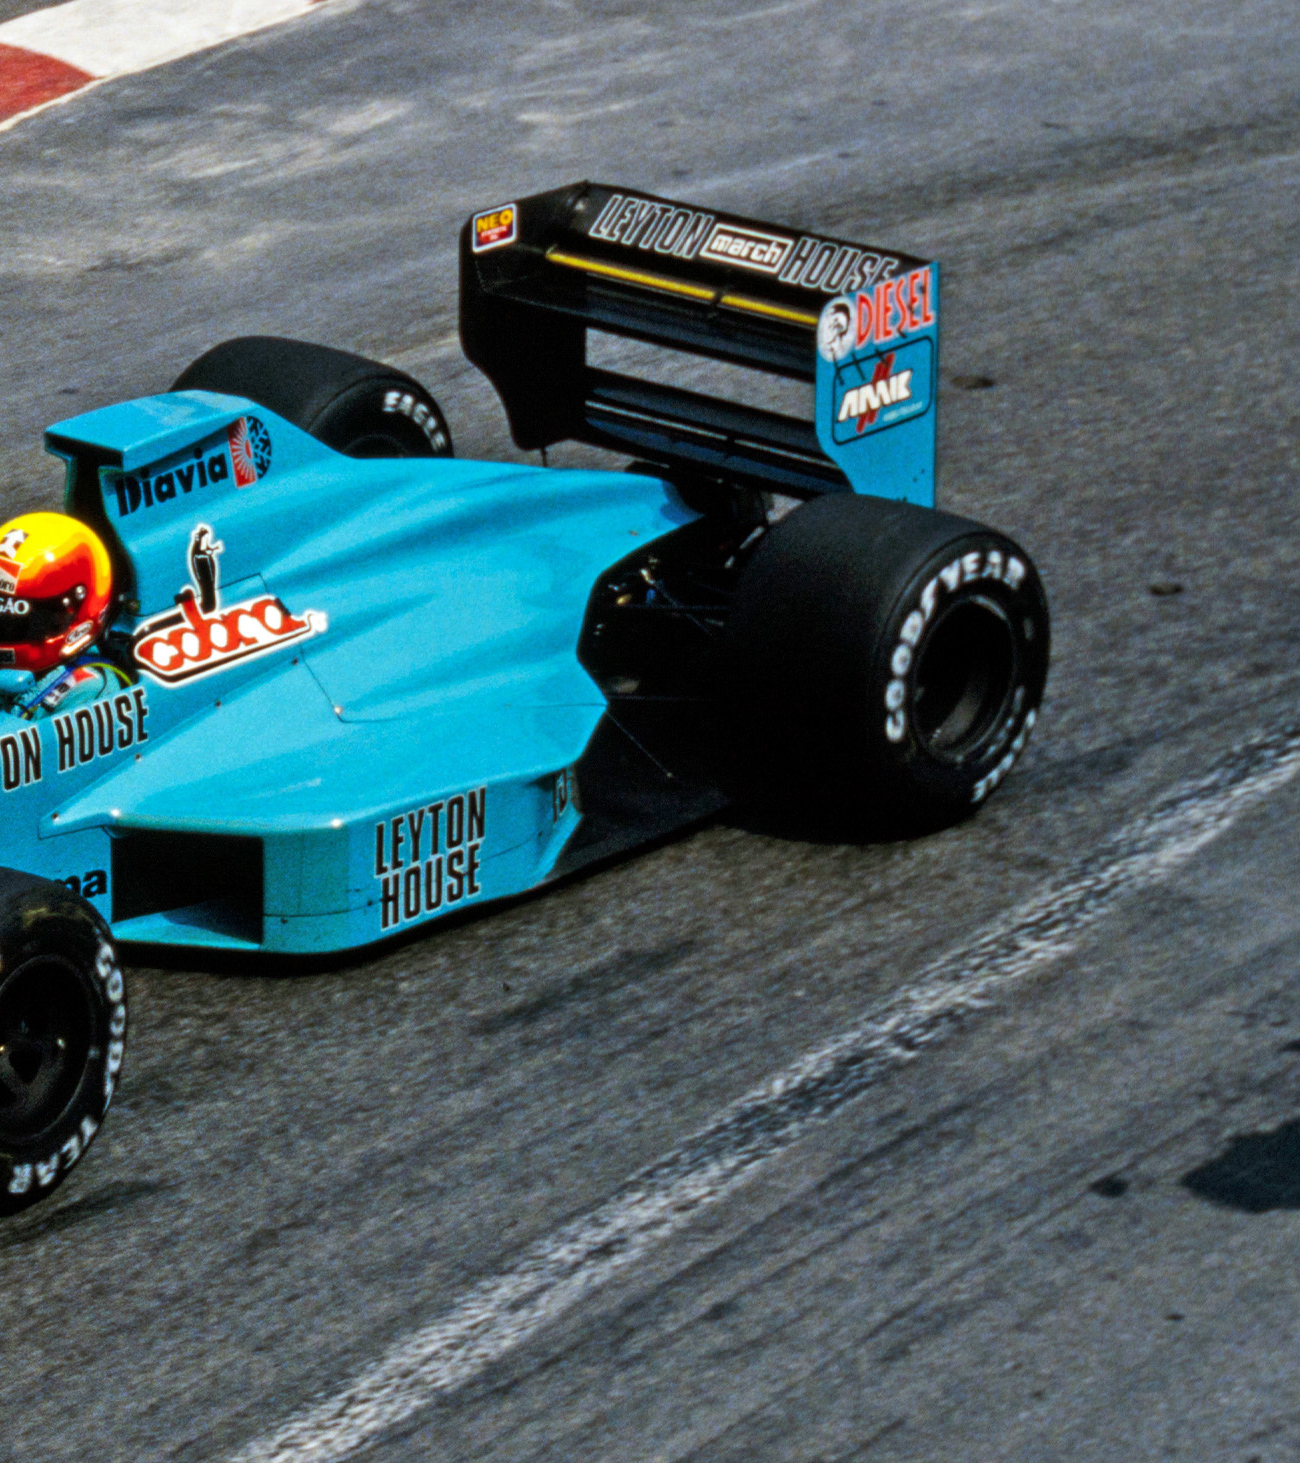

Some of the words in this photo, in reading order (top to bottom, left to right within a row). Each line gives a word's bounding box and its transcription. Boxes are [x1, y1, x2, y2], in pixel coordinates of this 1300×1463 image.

[476, 209, 513, 233] NEO
[589, 194, 714, 260] LEYTON
[709, 232, 783, 265] march
[778, 236, 899, 295] HOUSE
[855, 267, 936, 350] DIESEL
[114, 452, 229, 518] Diavia
[52, 686, 149, 774] HOUSE
[374, 785, 487, 879] LEYTON
[380, 843, 481, 932] HOUSE
